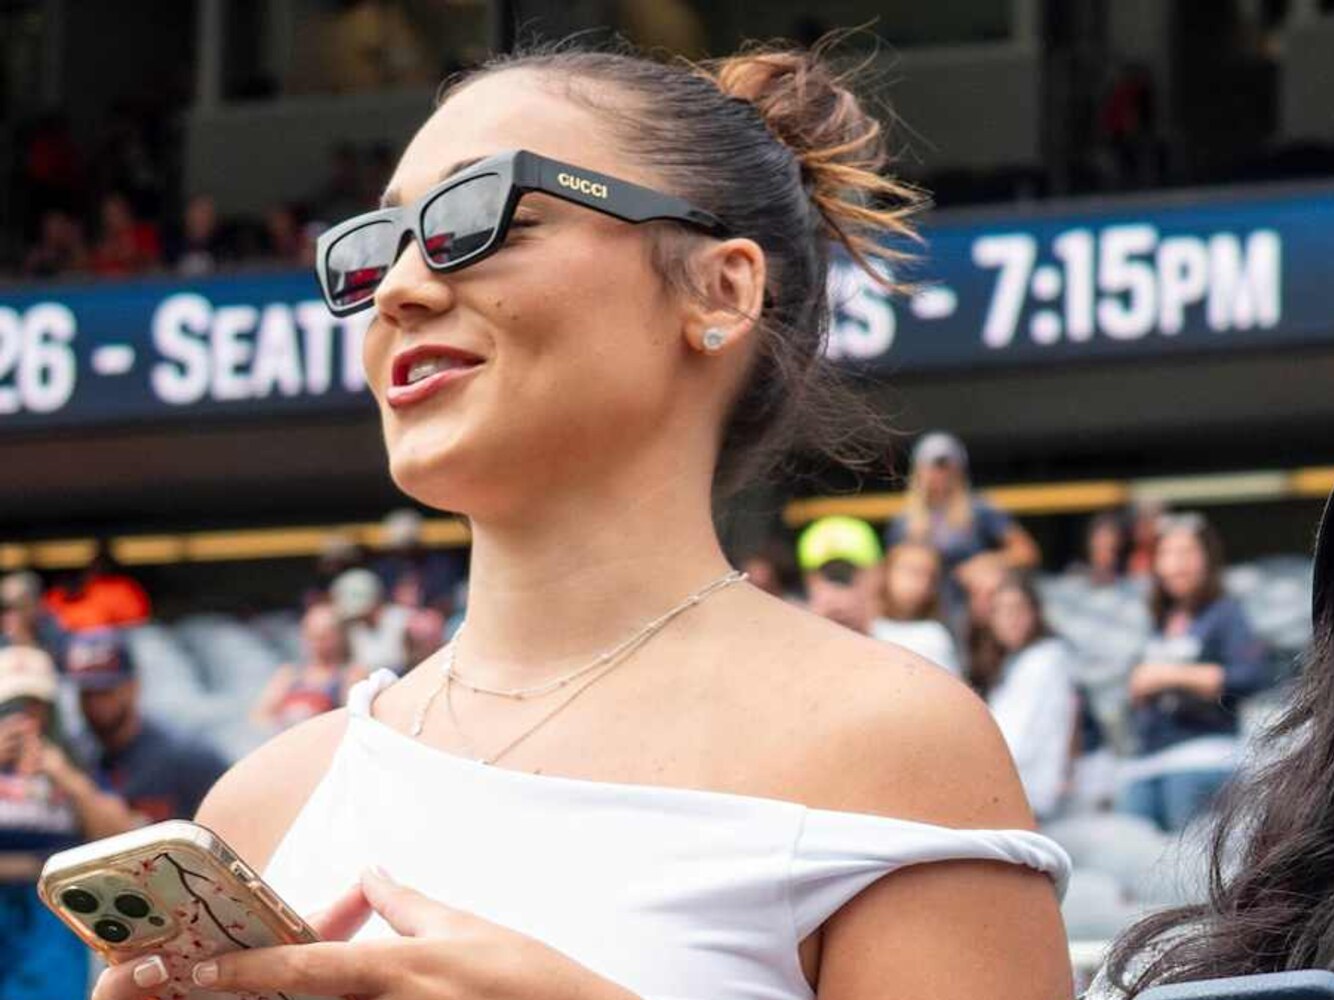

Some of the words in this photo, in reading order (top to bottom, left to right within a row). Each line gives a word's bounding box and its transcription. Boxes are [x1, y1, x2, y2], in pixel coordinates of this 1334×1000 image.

[557, 172, 608, 199] GUCCI
[971, 223, 1282, 349] 7:15PM
[151, 292, 367, 405] SEATT
